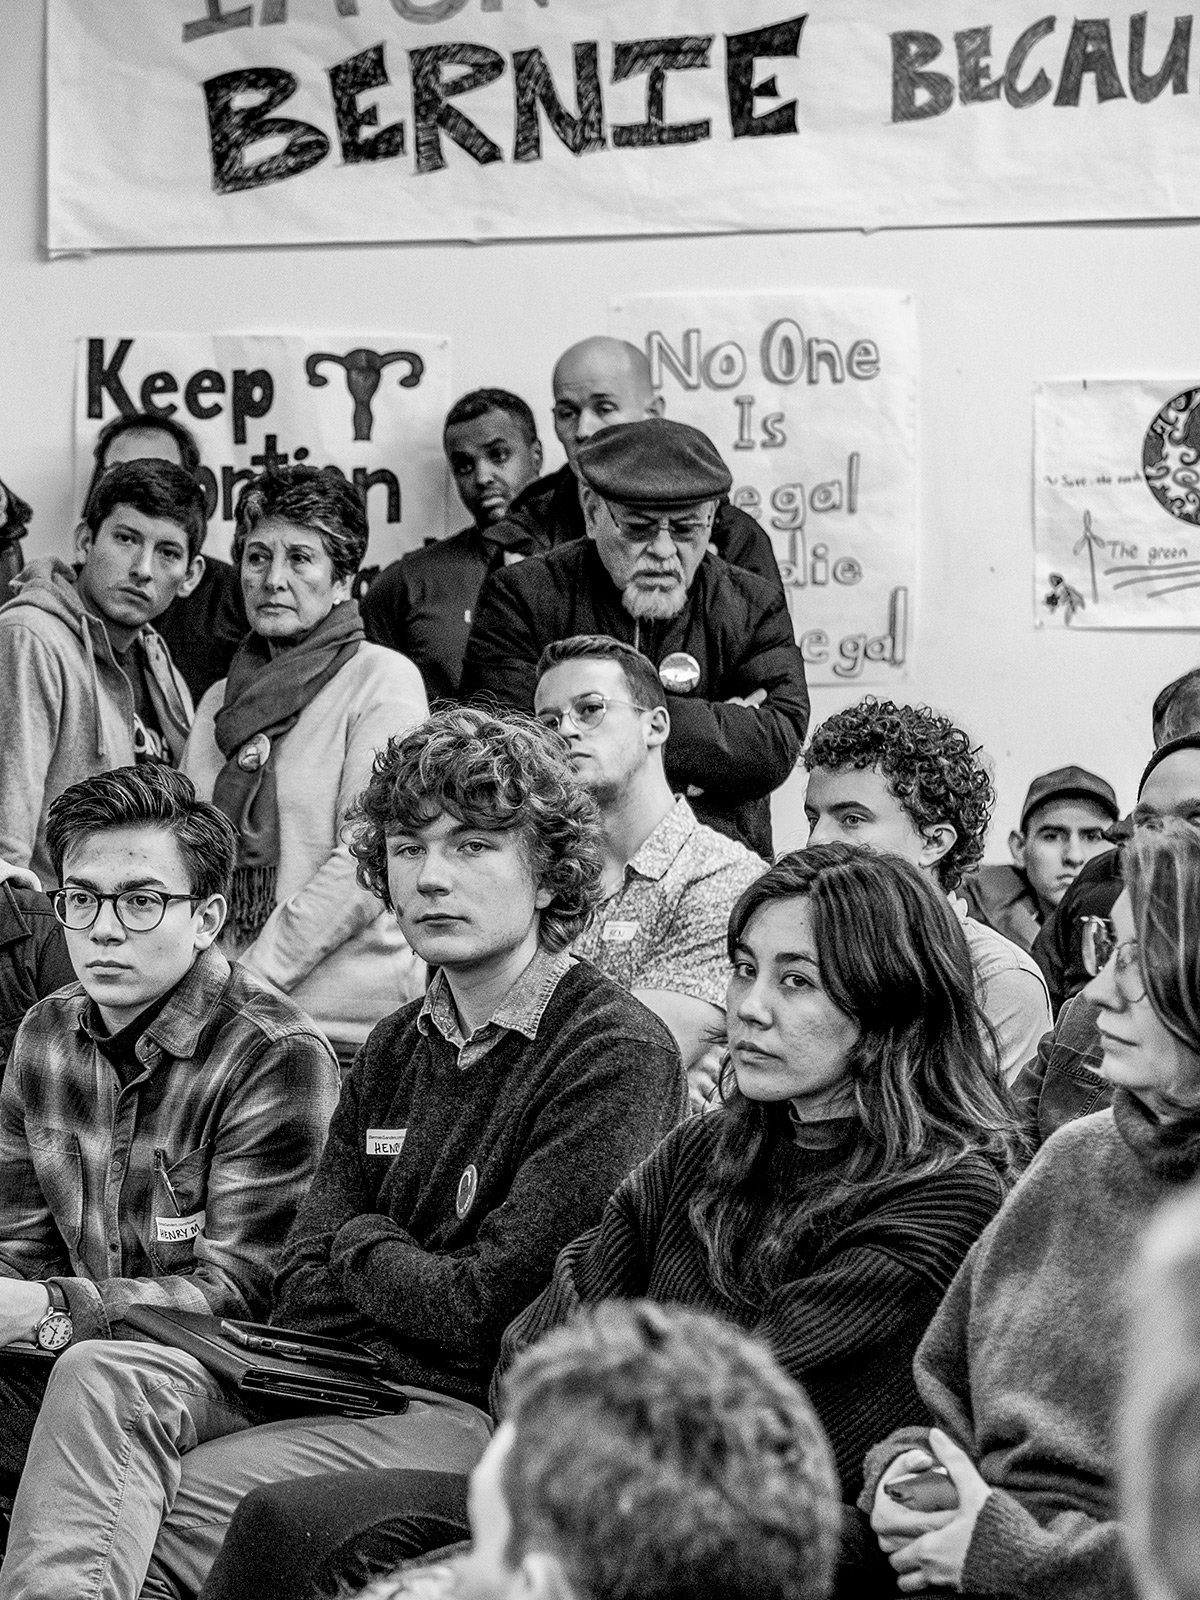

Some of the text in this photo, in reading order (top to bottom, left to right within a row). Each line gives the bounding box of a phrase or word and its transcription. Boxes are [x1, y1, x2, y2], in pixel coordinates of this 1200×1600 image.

[199, 11, 1195, 195] BERNIE BECAU
[87, 338, 274, 445] Keep
[646, 317, 881, 391] No One
[733, 395, 788, 450] Is
[732, 451, 861, 531] egal
[778, 528, 864, 588] die
[1106, 540, 1189, 566] The green
[786, 586, 909, 679] egal
